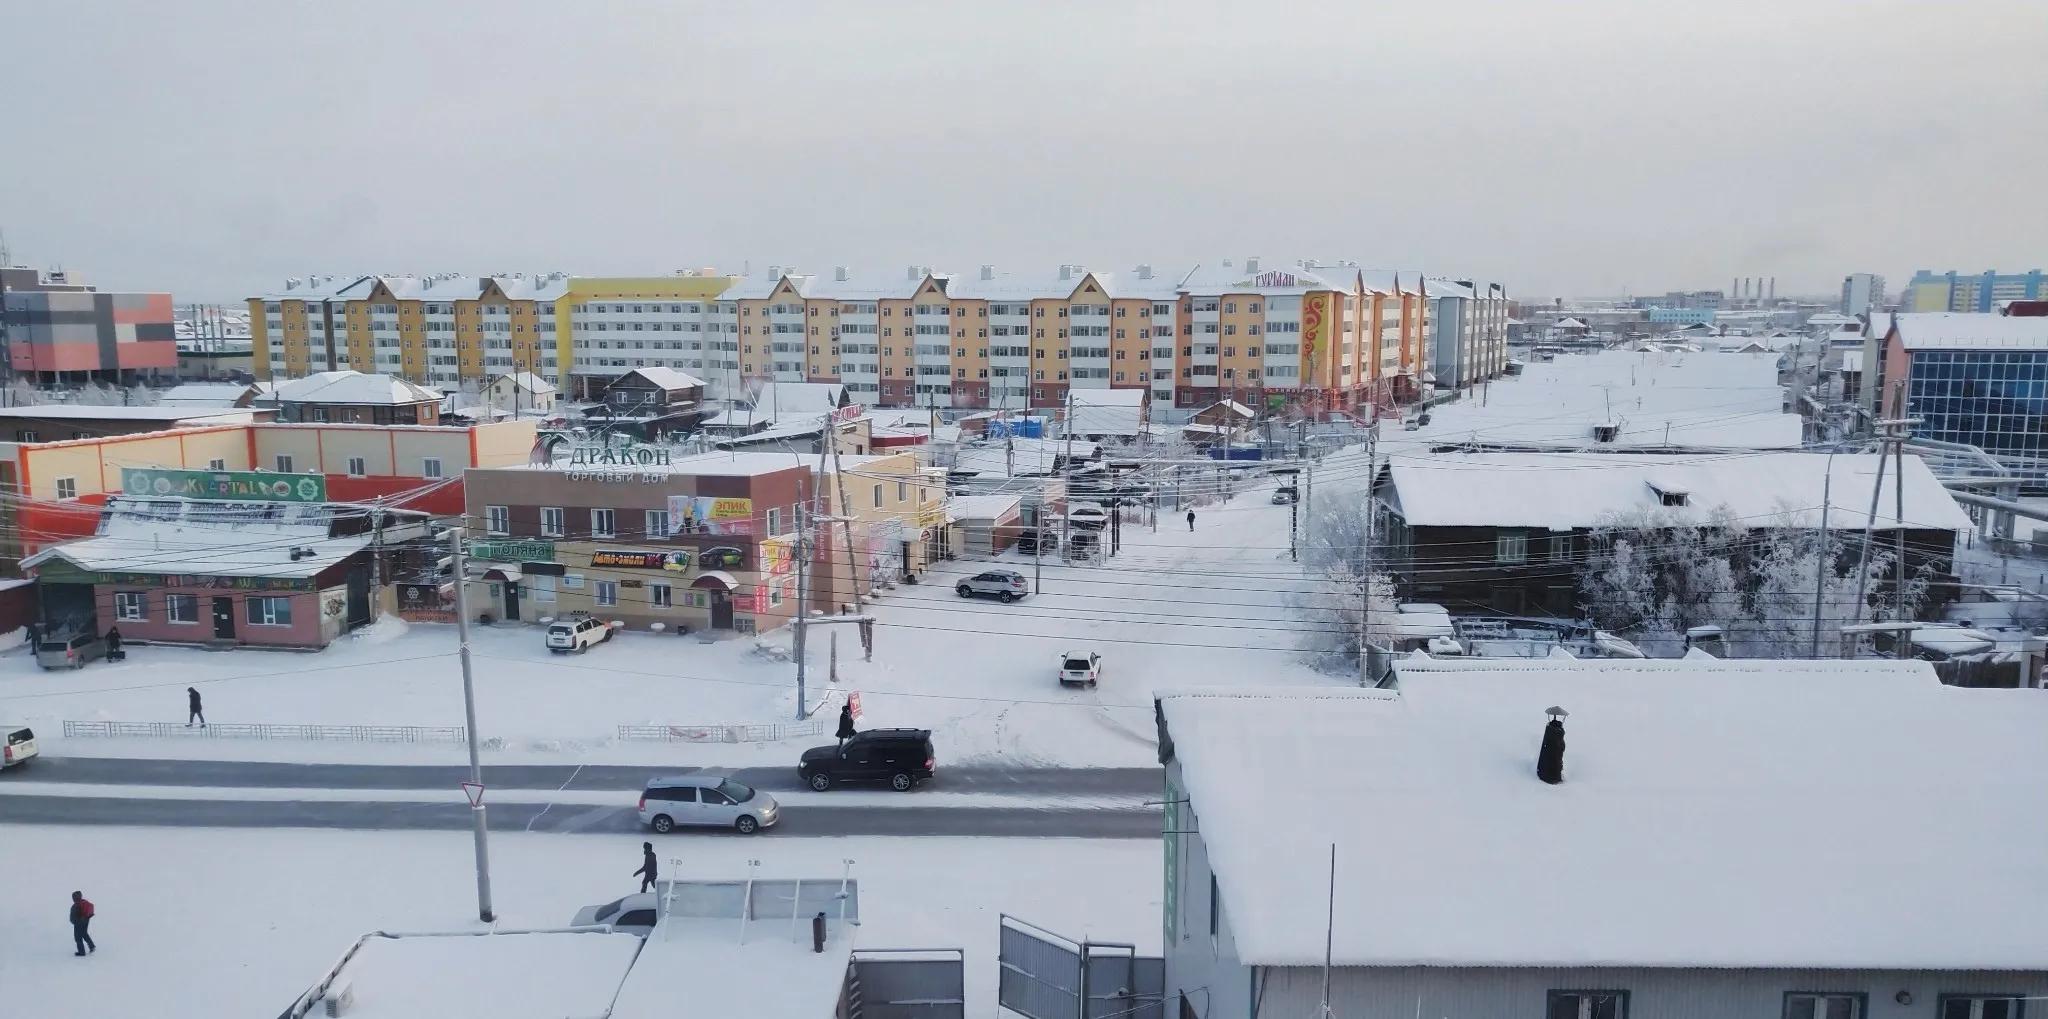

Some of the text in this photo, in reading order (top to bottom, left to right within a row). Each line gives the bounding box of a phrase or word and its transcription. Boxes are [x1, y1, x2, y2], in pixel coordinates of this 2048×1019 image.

[569, 447, 670, 467] ДРАКОН
[642, 473, 669, 484] ДОМ
[716, 501, 746, 510] ЭПИК
